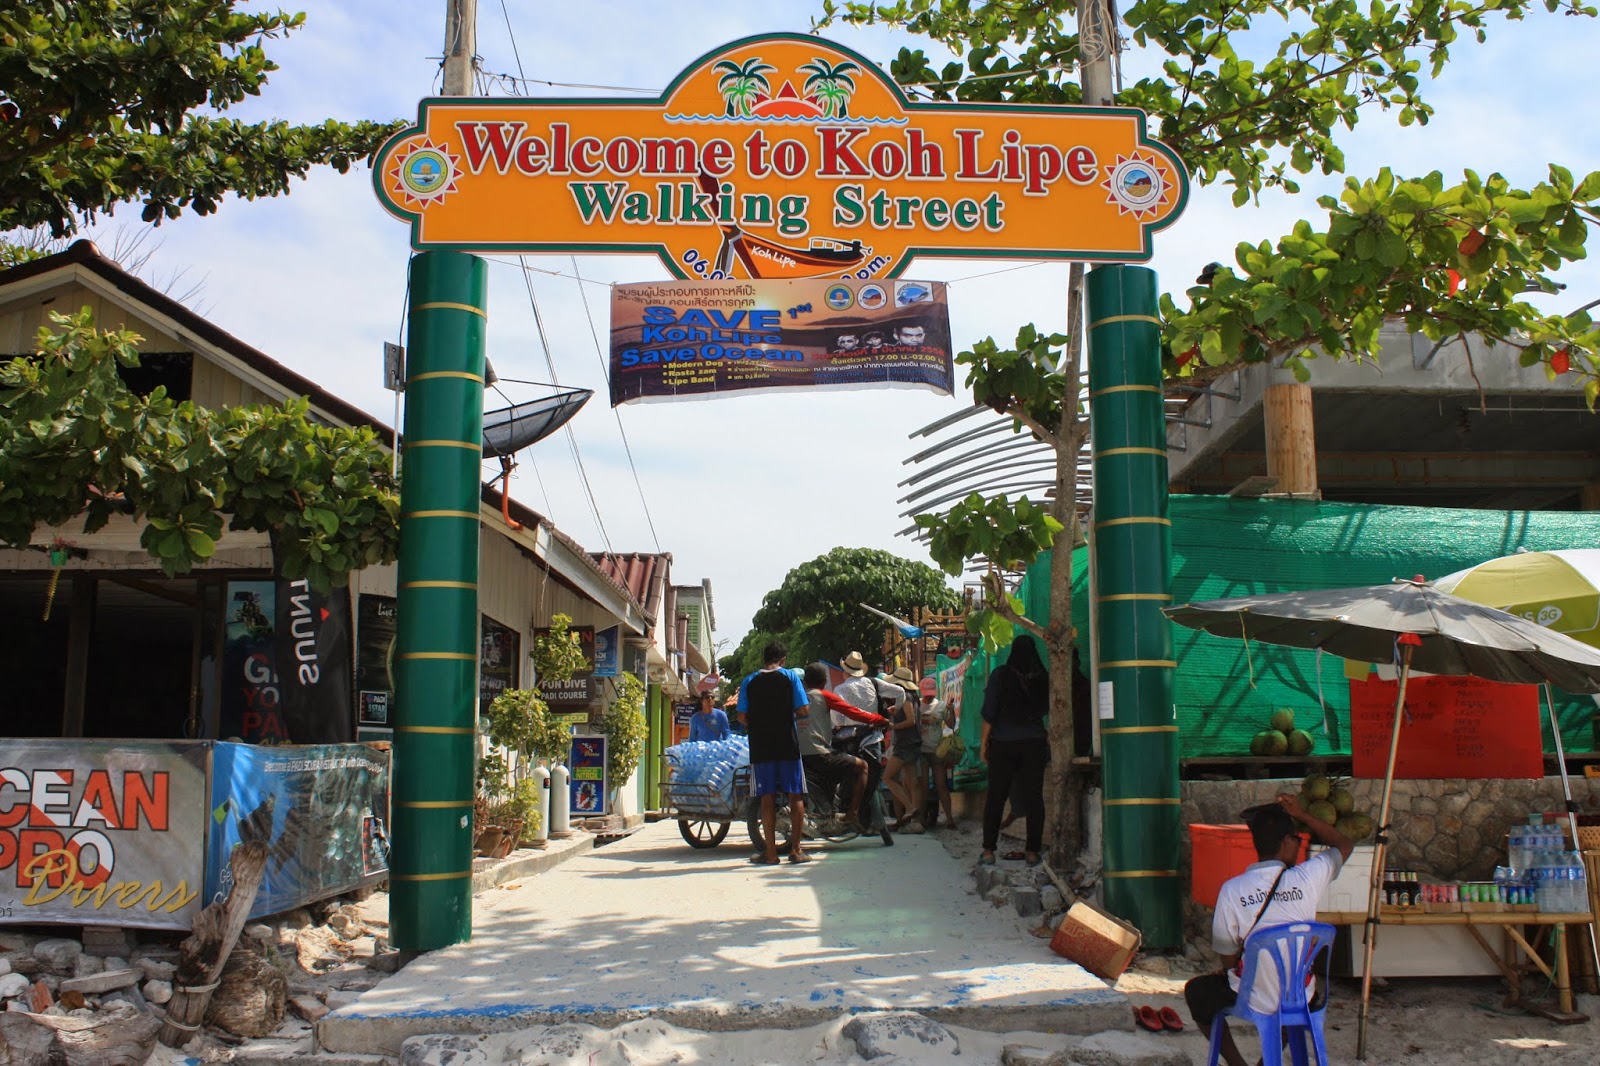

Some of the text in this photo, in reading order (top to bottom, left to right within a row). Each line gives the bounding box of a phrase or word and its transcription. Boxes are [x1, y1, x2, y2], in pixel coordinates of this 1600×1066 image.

[455, 122, 735, 178] Welcome
[746, 130, 808, 178] to
[816, 127, 946, 180] Koh
[953, 129, 1098, 196] Lipe
[569, 182, 1004, 238] Walking Street
[683, 249, 735, 279] 06.0
[751, 246, 797, 268] Koh Lipe
[642, 306, 782, 332] SAVE
[641, 326, 782, 345] Koh Lipe
[621, 343, 804, 366] Save Ocean
[690, 376, 715, 384] Band
[1540, 608, 1558, 621] 3G
[542, 679, 587, 689] FUN DIVE
[541, 691, 587, 700] PADI COURSE
[21, 848, 199, 914] Divers
